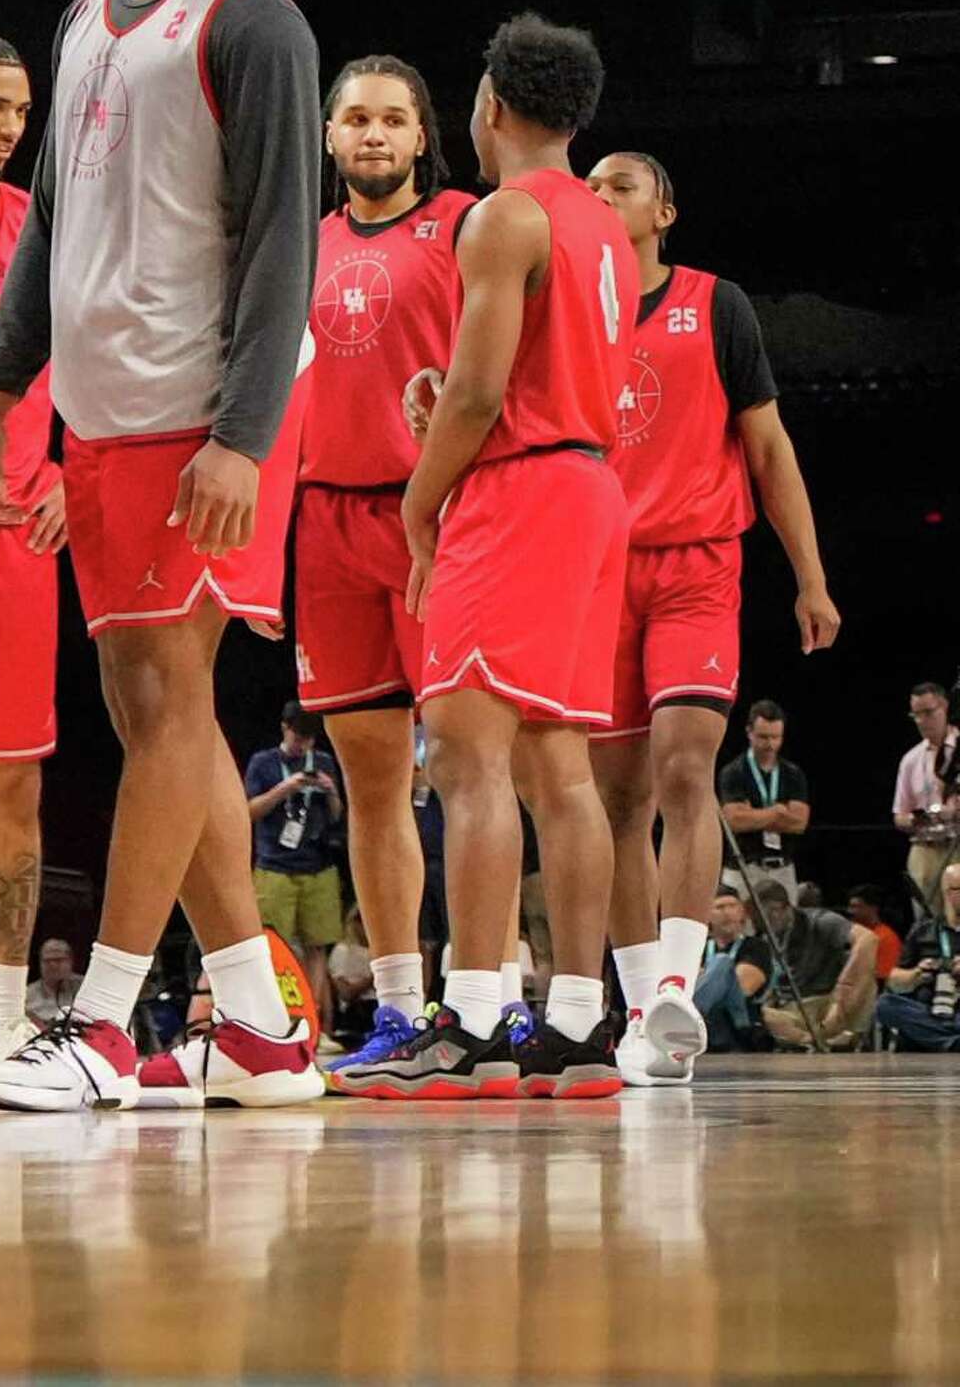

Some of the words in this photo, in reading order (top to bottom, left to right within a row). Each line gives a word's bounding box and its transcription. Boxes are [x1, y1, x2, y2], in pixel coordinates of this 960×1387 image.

[163, 10, 187, 40] 2
[415, 220, 439, 241] 21
[667, 307, 699, 334] 25
